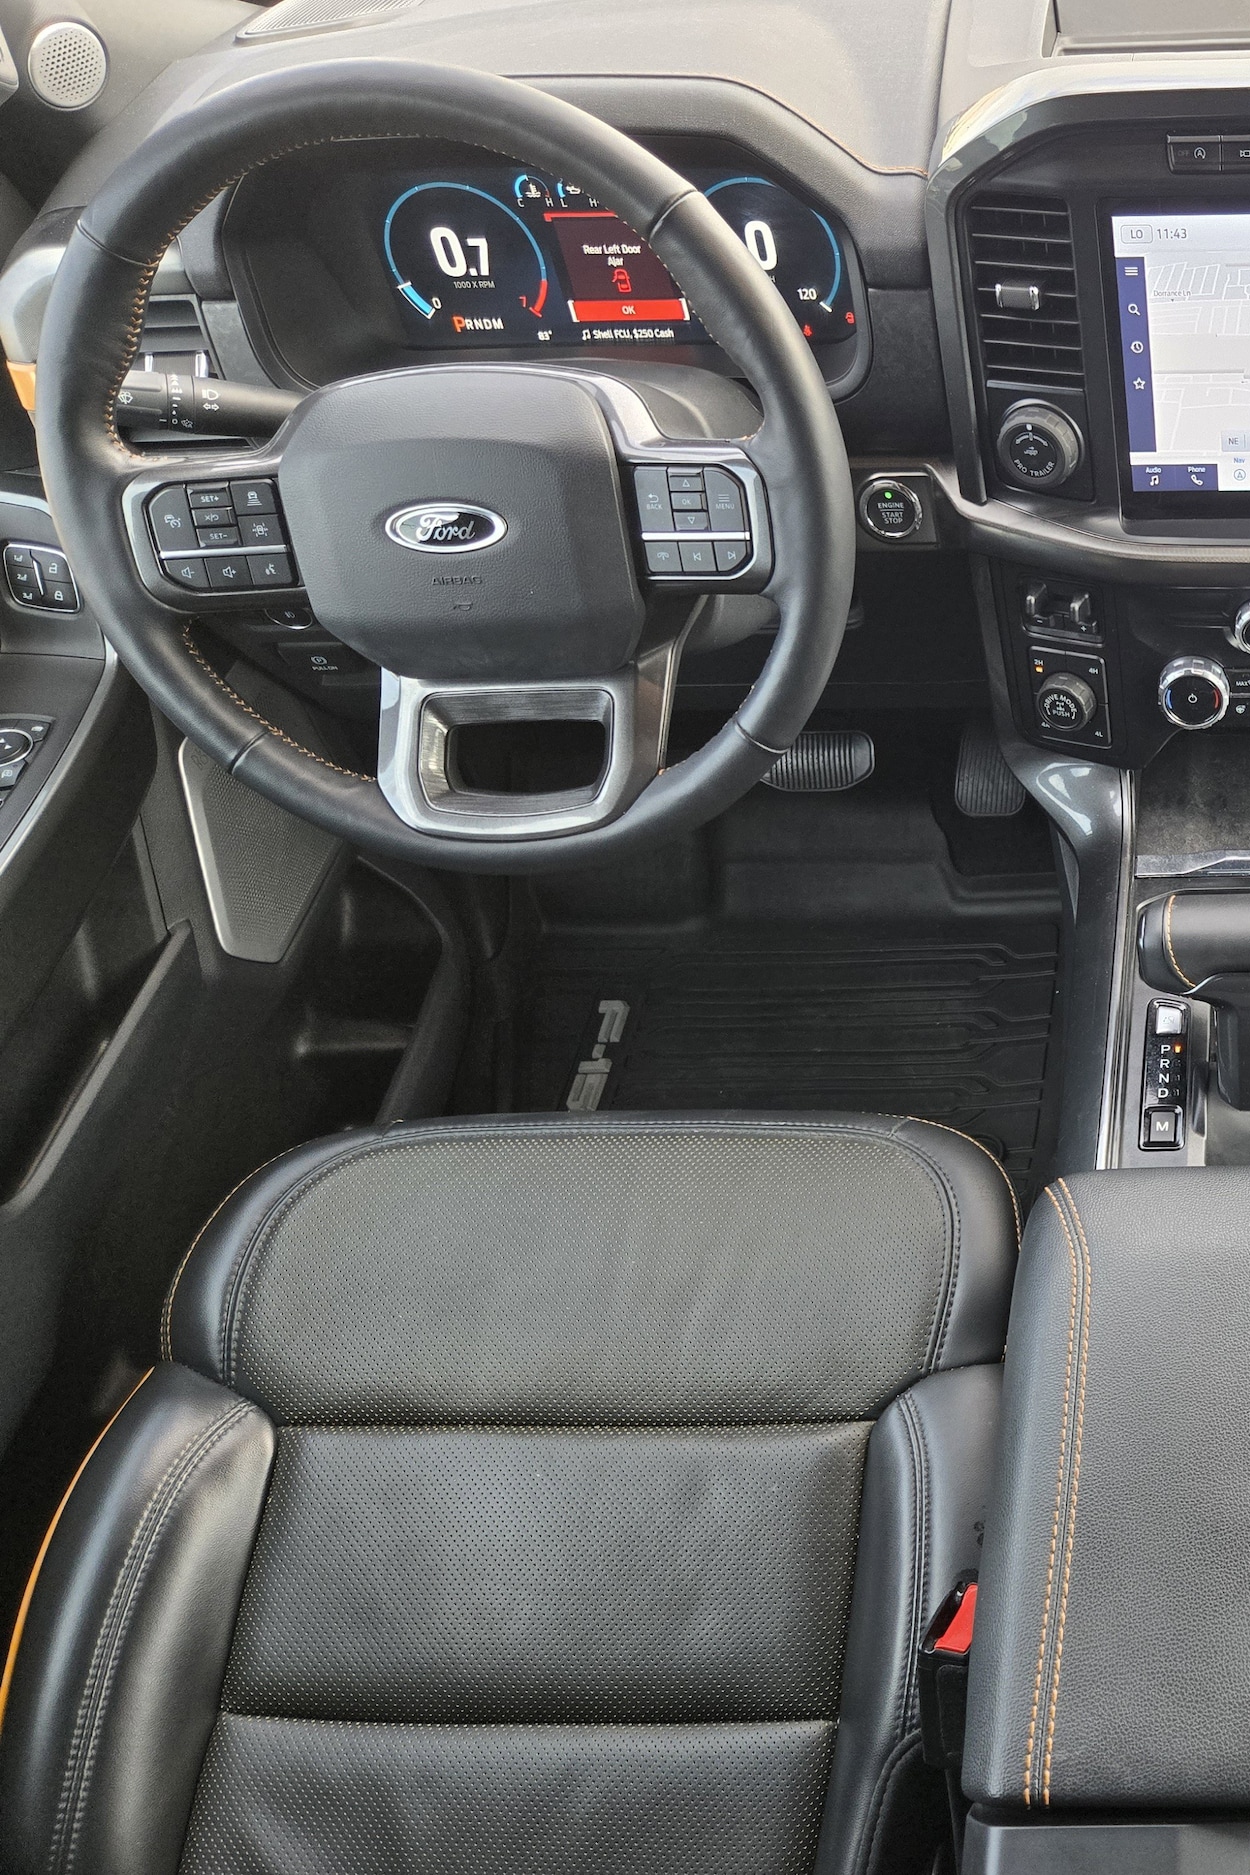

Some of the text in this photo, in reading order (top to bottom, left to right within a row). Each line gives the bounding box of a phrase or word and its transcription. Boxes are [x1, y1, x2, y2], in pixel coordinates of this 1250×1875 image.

[517, 198, 525, 207] C
[545, 198, 554, 207] H
[560, 198, 568, 207] L
[1130, 229, 1143, 239] LO
[1157, 228, 1187, 239] 11:43
[582, 243, 641, 255] Rear Left Door
[744, 220, 777, 270] 0
[430, 226, 490, 277] 0.7
[607, 255, 623, 267] Ajar
[453, 281, 472, 289] 1000
[478, 280, 495, 288] RPM
[797, 288, 817, 300] 120
[431, 296, 442, 310] 0
[519, 296, 527, 307] 7
[621, 305, 636, 315] OK
[593, 329, 613, 340] Shell
[633, 328, 652, 340] $250
[654, 328, 674, 339] Cash
[1228, 437, 1239, 445] NE
[1014, 459, 1055, 477] PRO TRAILER
[415, 513, 476, 541] Ford
[1044, 693, 1077, 713] DRIVE MODE
[1052, 709, 1070, 718] PUSH
[1161, 1044, 1171, 1054] P
[1160, 1059, 1170, 1069] R
[1159, 1073, 1170, 1083] N
[1158, 1088, 1169, 1098] D
[1156, 1121, 1169, 1131] M
